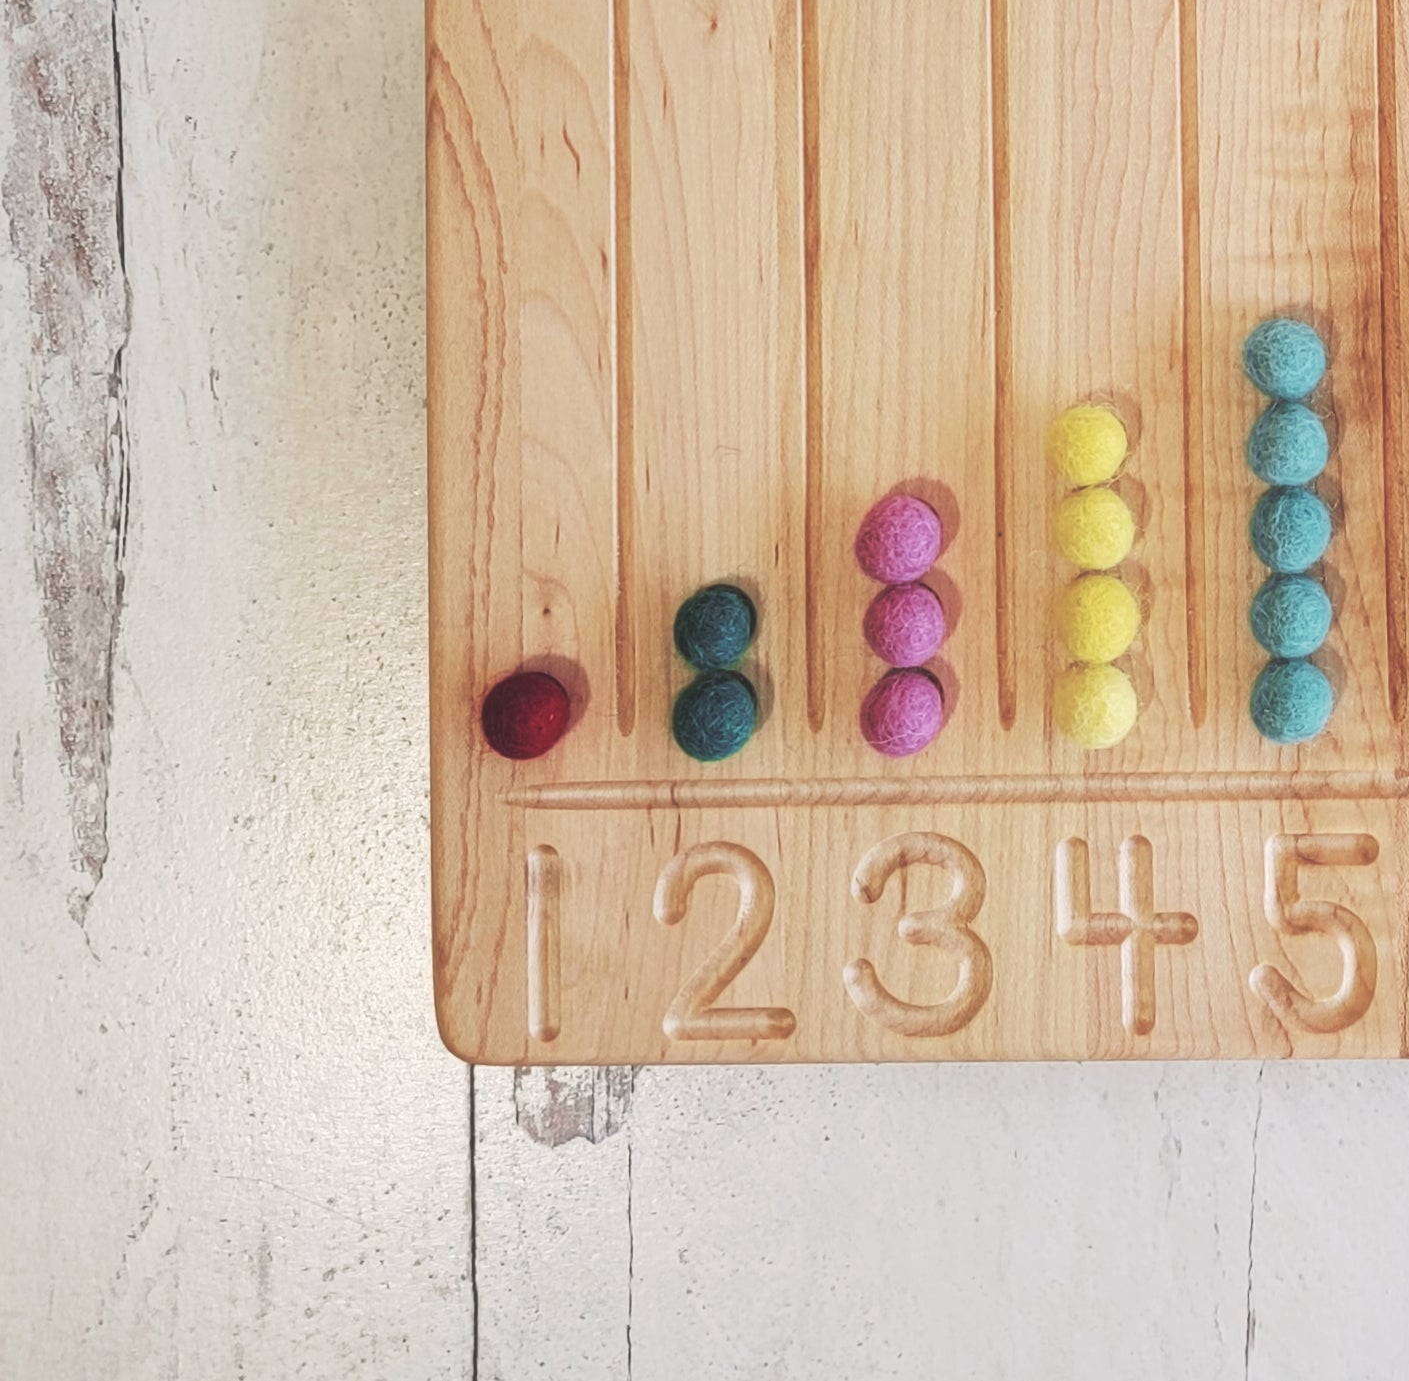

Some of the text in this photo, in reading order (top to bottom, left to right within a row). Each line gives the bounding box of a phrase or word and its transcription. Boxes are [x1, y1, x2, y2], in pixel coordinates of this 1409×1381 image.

[526, 843, 561, 1042] 1
[653, 841, 797, 1040] 2
[843, 831, 993, 1037] 3
[1056, 834, 1199, 1036] 4
[1249, 833, 1380, 1033] 5
